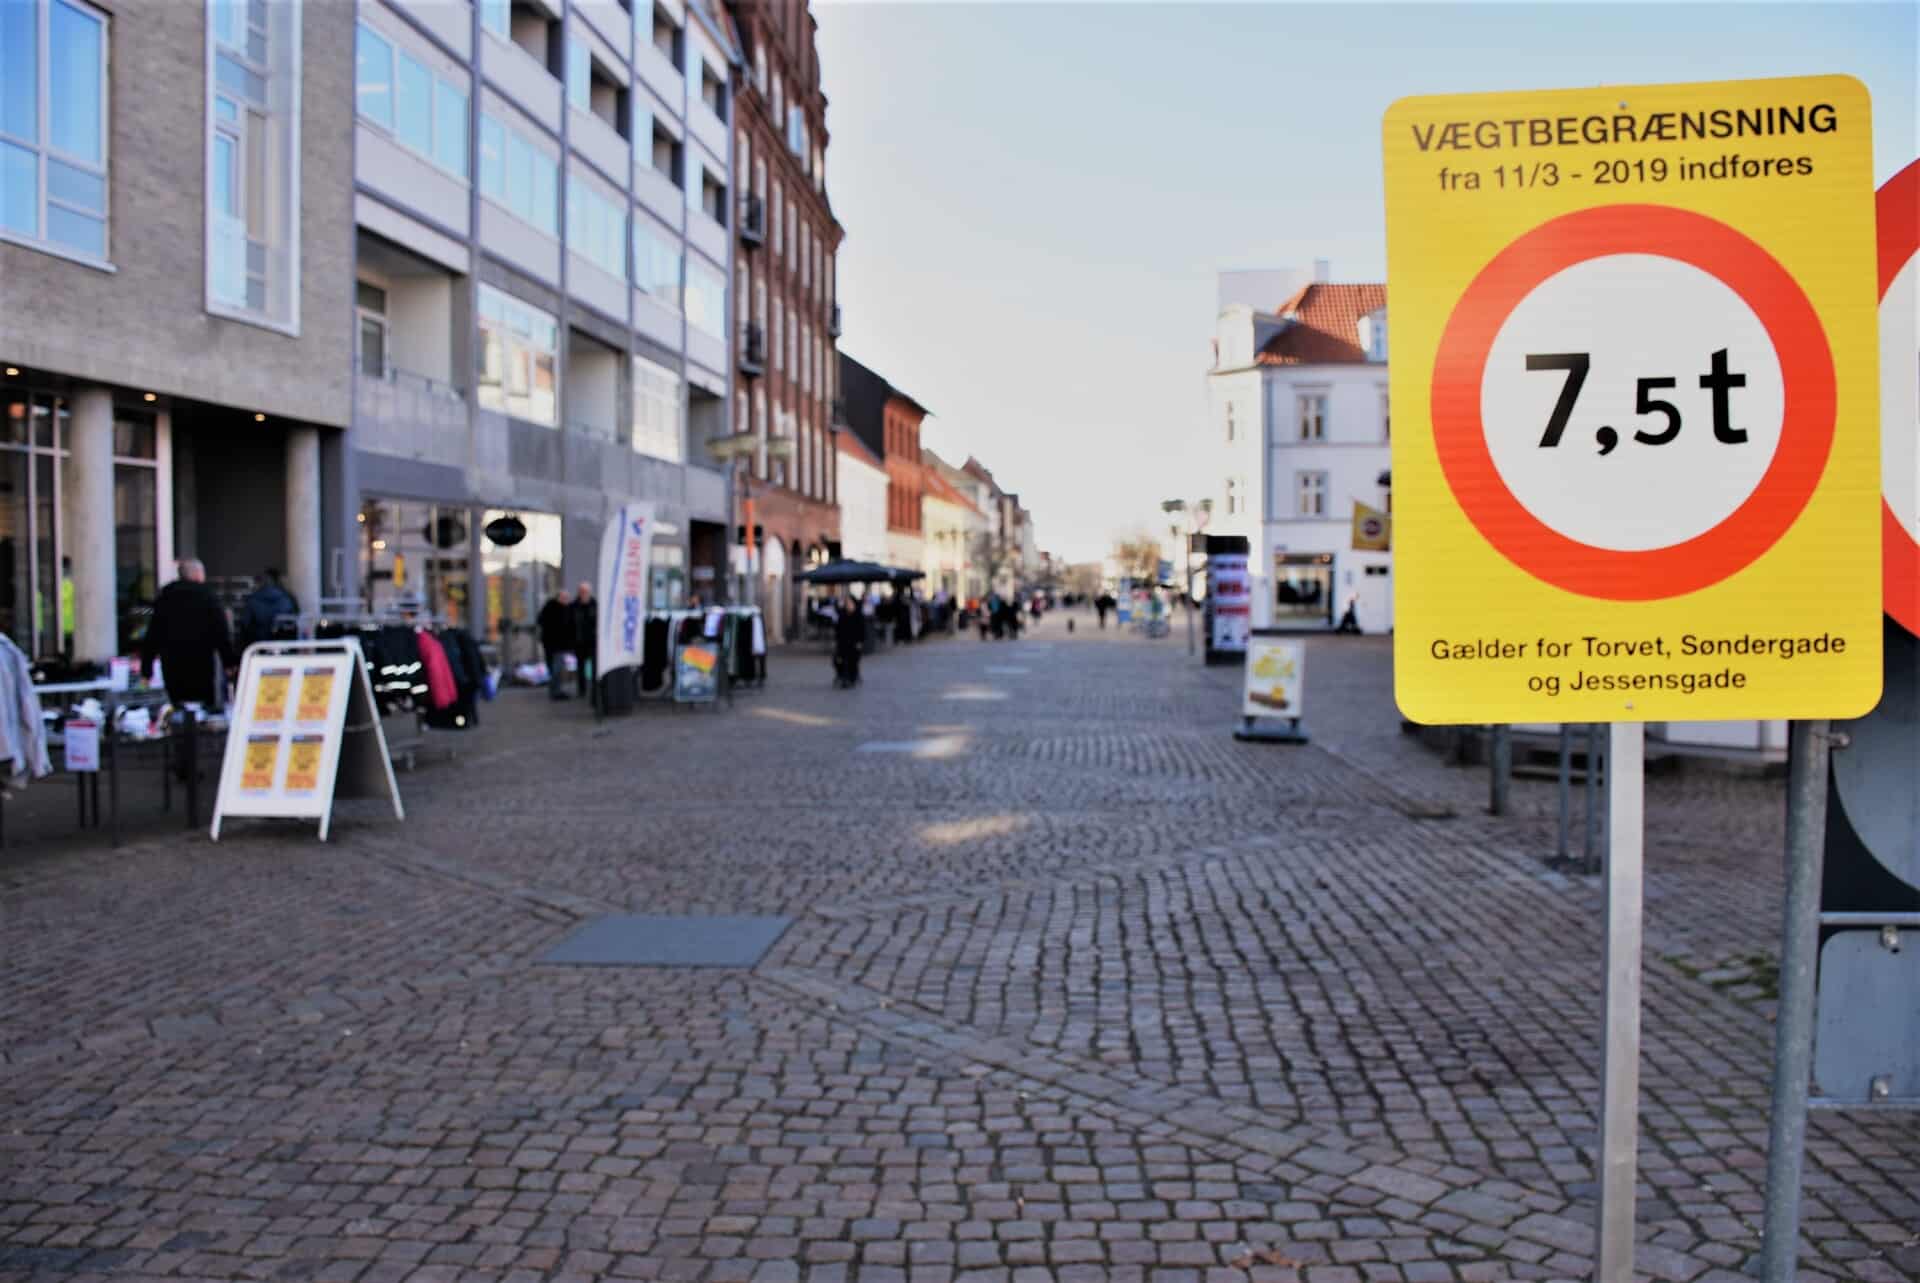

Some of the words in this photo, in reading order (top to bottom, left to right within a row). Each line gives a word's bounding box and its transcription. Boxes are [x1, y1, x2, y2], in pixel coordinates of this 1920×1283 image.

[1412, 103, 1838, 152] VÆGTBEGRÆNSNING
[1439, 167, 1481, 190] fra
[1494, 163, 1560, 188] 11/3
[1593, 158, 1668, 184] 2019
[1680, 154, 1814, 181] indføres
[1431, 637, 1527, 661] Gælder
[1536, 637, 1572, 658] for
[1581, 636, 1671, 658] Torvet,
[1681, 632, 1846, 661] Søndergade
[1528, 675, 1560, 697] og
[1570, 668, 1747, 695] Jessensgade
